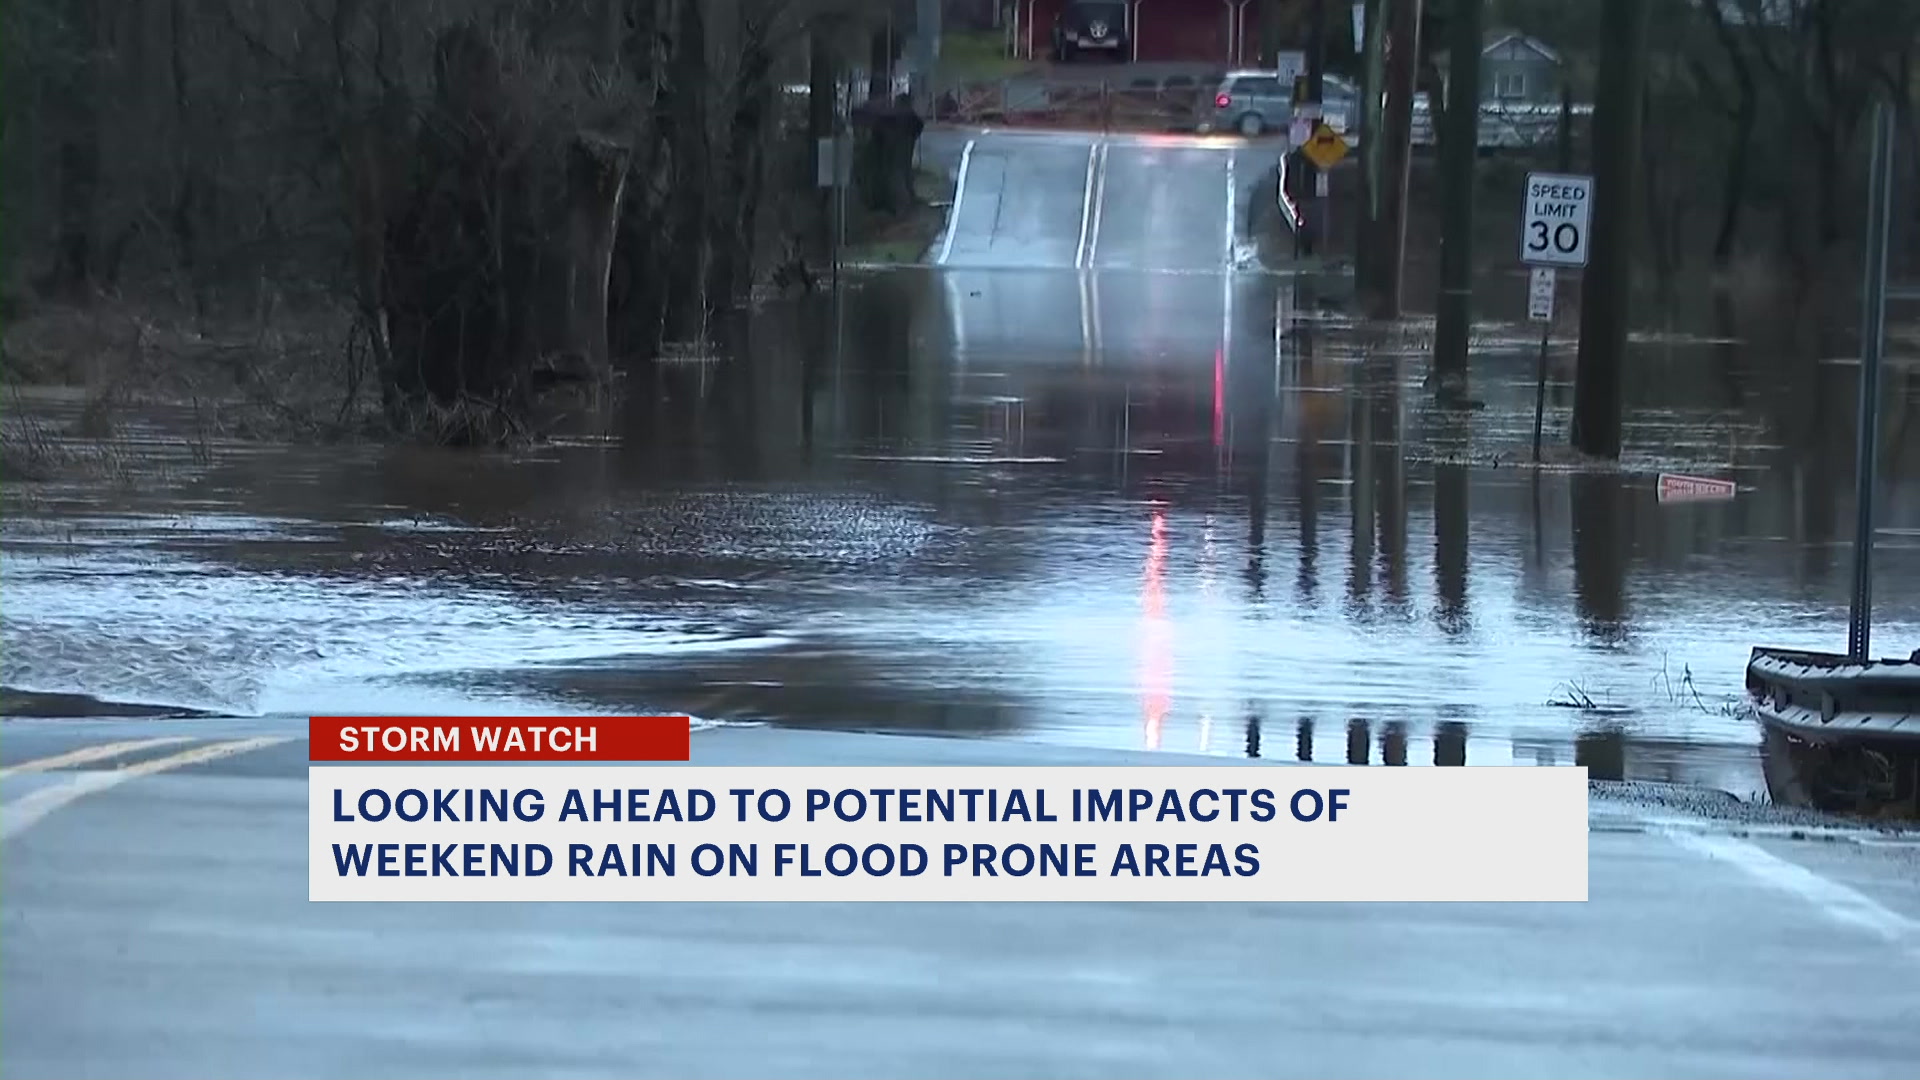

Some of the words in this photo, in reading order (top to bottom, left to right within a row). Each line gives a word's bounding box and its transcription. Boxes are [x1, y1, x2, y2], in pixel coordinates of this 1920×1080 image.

[1530, 184, 1585, 201] SPEED
[1534, 203, 1577, 218] LIMIT
[1528, 221, 1579, 254] 30
